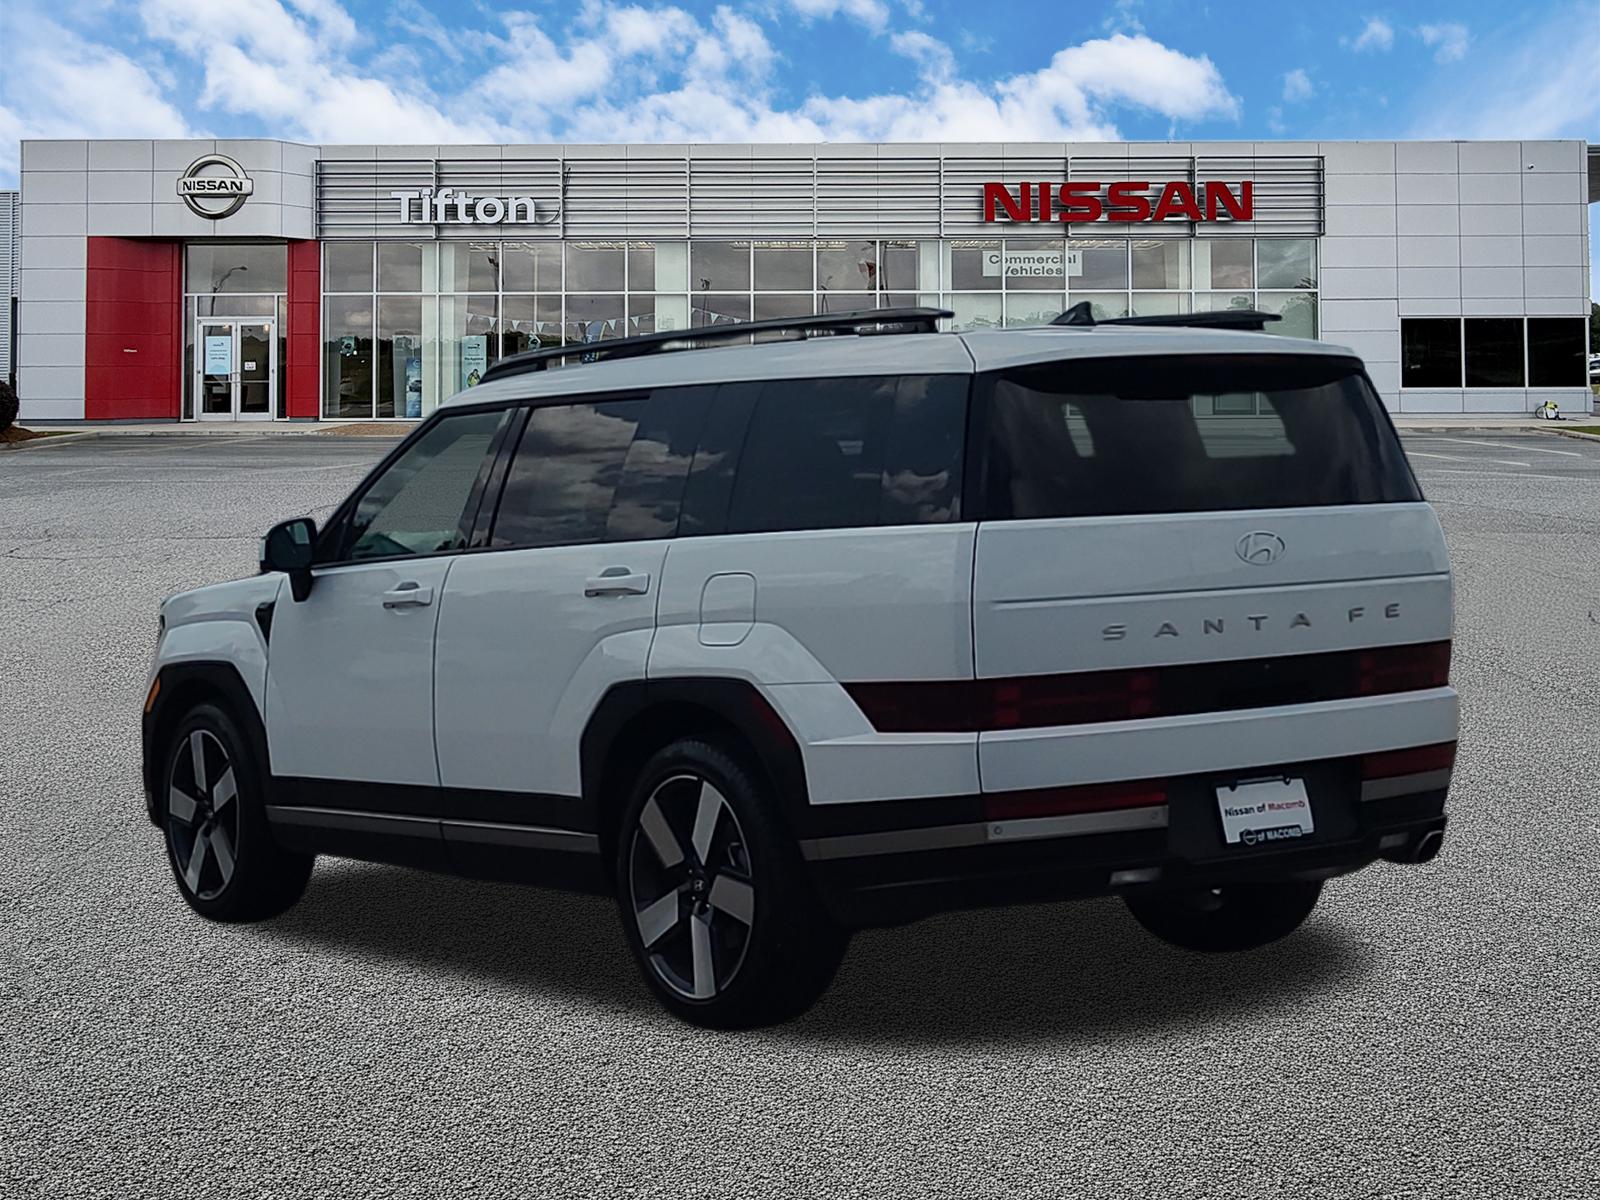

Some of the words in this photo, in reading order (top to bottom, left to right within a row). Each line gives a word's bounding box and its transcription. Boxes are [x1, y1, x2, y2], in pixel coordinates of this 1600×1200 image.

[181, 178, 244, 193] NISSAN
[983, 180, 1253, 222] NISSAN
[390, 188, 536, 225] Tifton
[1100, 612, 1312, 641] SANTA
[1347, 603, 1401, 623] FE
[1224, 806, 1255, 817] Nissan
[1256, 803, 1266, 813] of
[1267, 800, 1305, 811] Macomb
